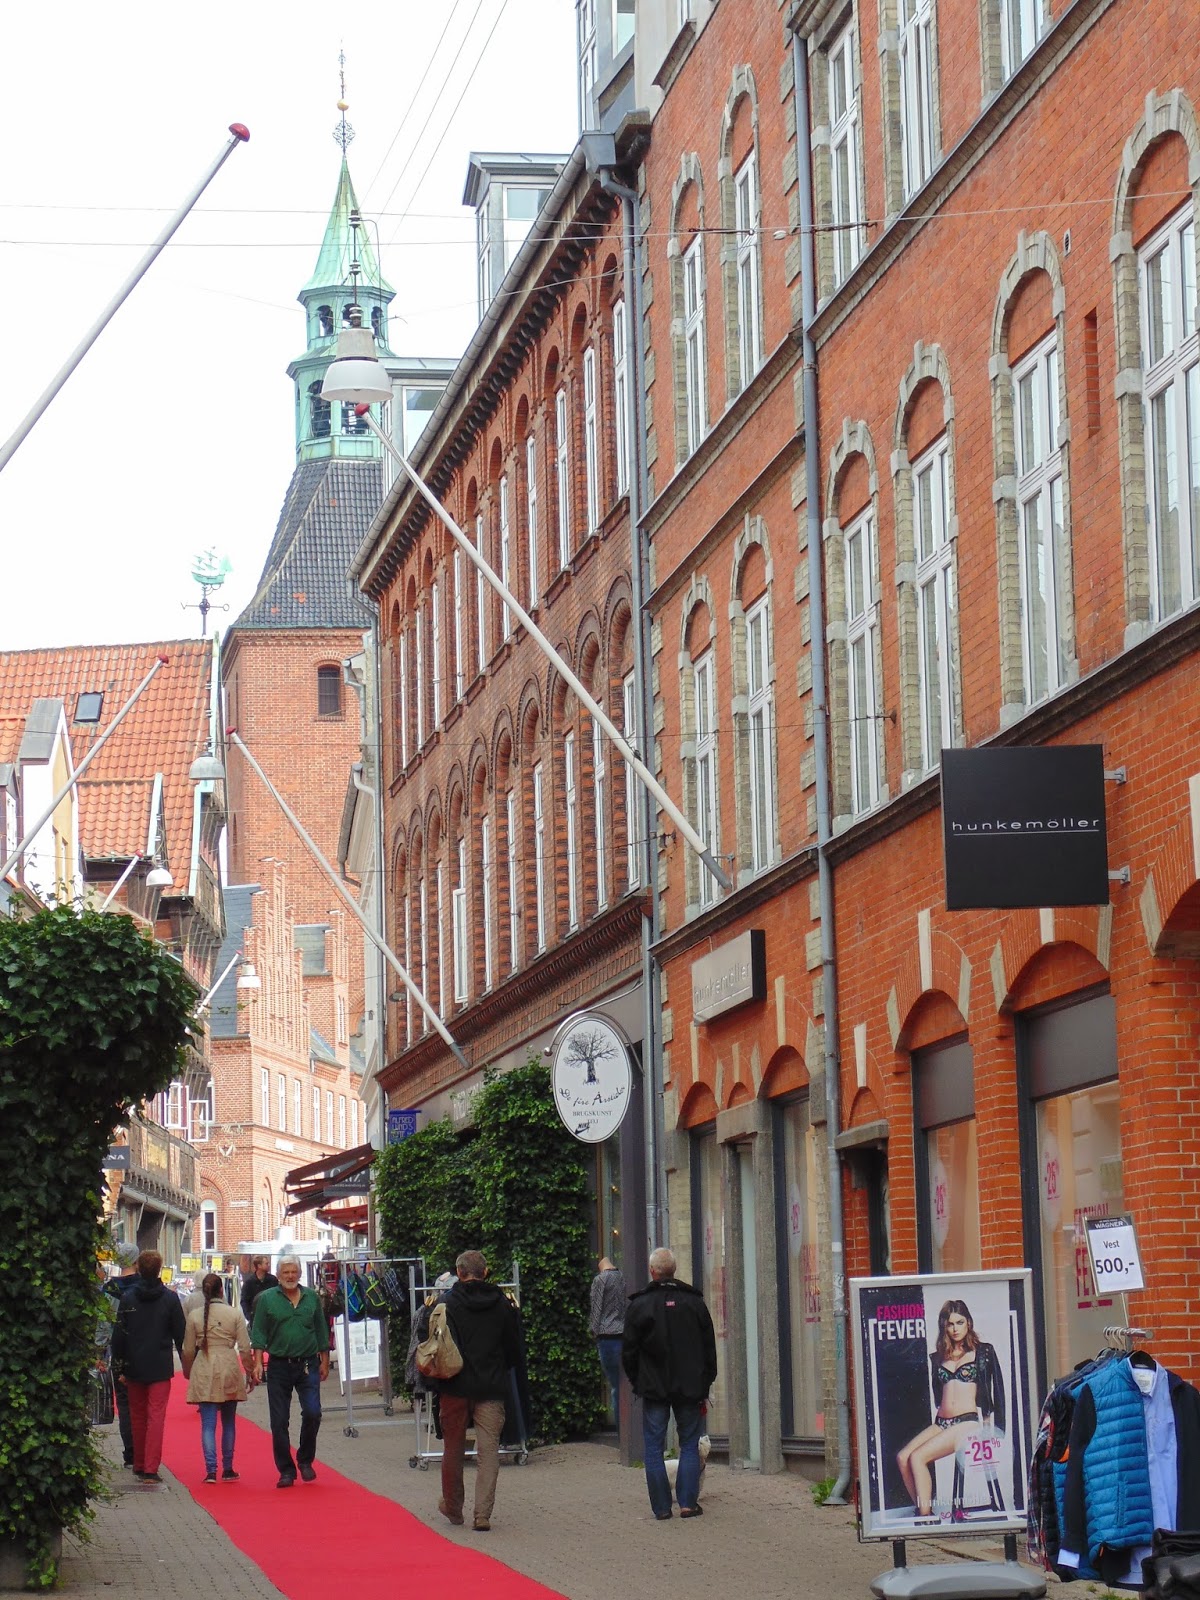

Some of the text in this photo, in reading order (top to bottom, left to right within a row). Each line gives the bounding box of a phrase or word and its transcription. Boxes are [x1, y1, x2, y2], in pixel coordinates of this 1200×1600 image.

[952, 818, 1100, 831] hunkemöller
[694, 962, 750, 1006] hunkemöller
[573, 1096, 589, 1107] fire
[391, 1116, 414, 1124] ALFRED
[1094, 1220, 1124, 1230] WAGNER
[1102, 1240, 1120, 1249] Vest
[1095, 1257, 1135, 1275] 500,-
[876, 1303, 925, 1320] FASHION
[877, 1318, 926, 1341] FEVER
[964, 1437, 1001, 1462] -25%
